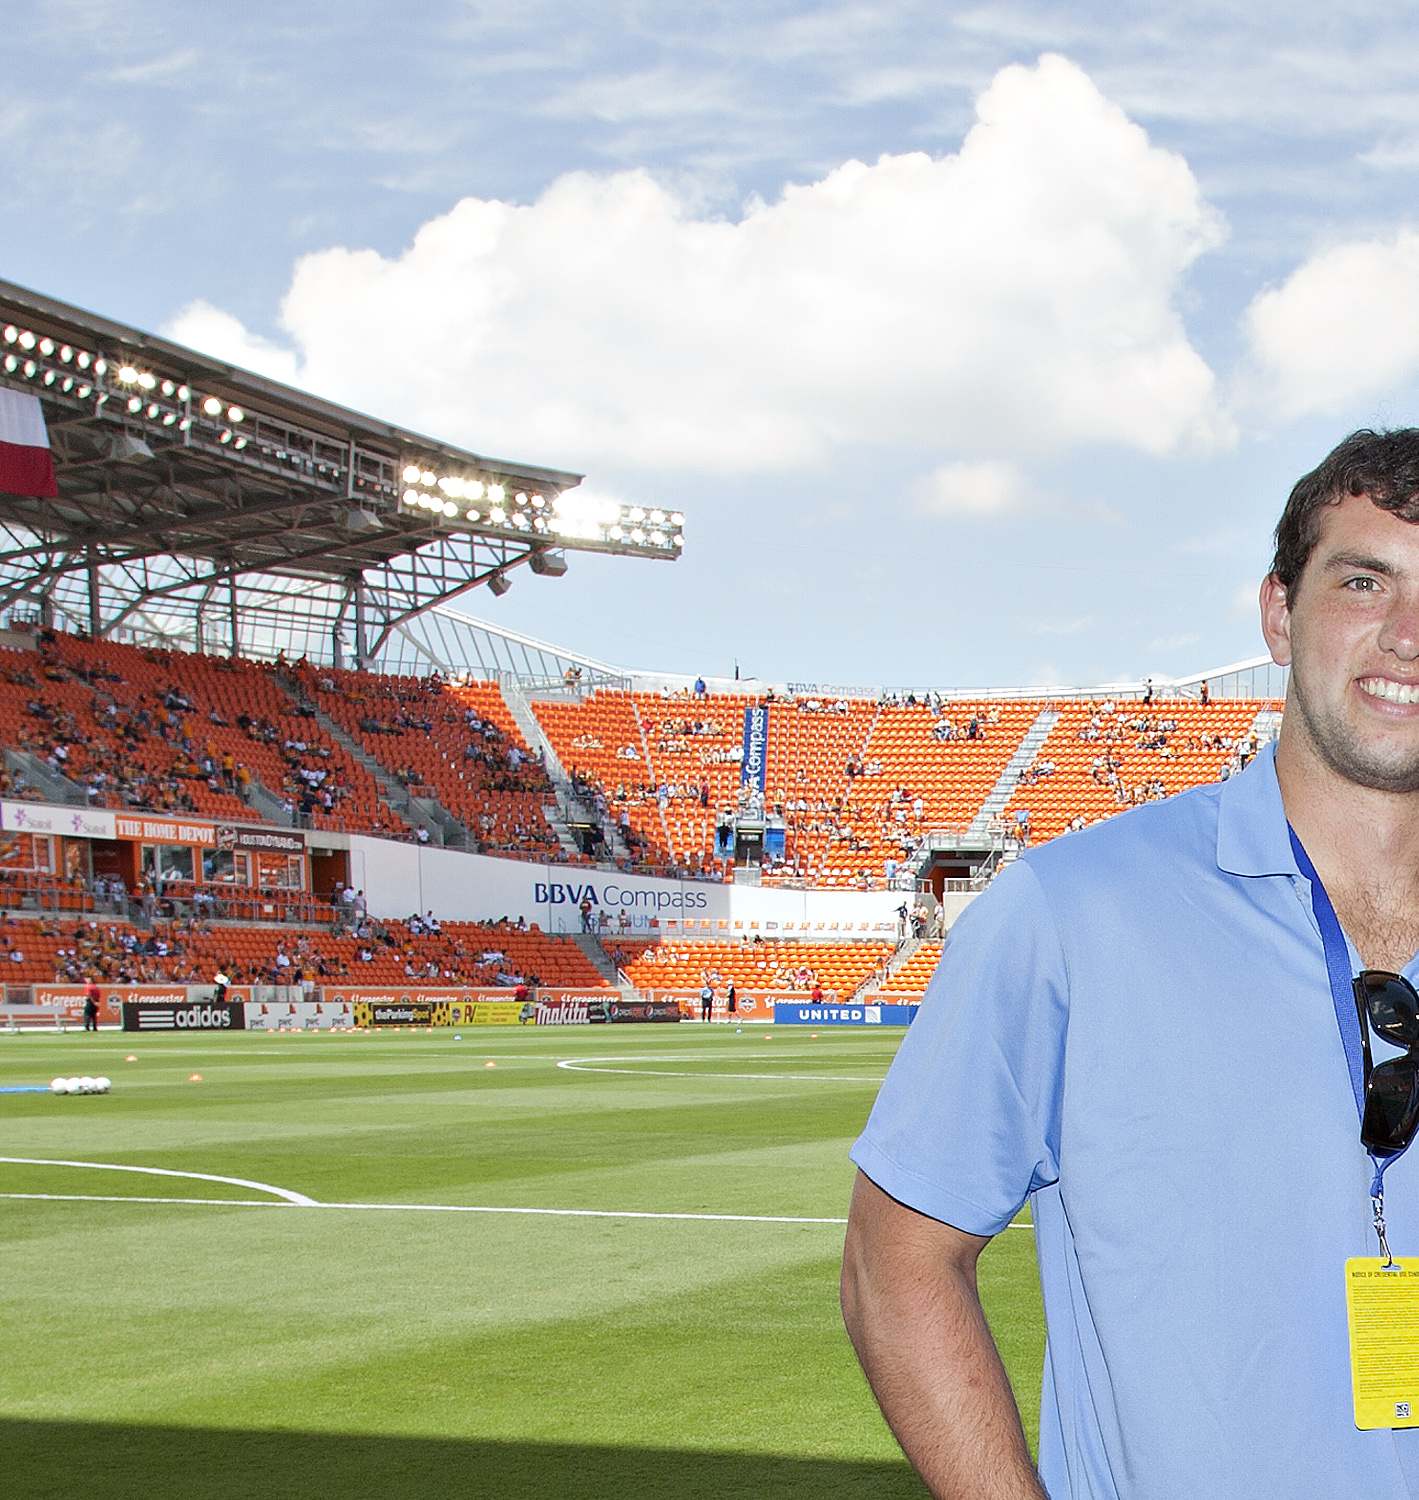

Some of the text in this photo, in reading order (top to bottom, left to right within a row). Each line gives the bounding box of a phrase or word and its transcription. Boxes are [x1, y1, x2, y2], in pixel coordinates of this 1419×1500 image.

[746, 708, 765, 775] Compass
[117, 820, 214, 843] THE HOME DEPOT
[535, 883, 707, 911] BBVA Compass
[176, 1006, 231, 1028] adidas
[799, 1009, 862, 1020] UNITED
